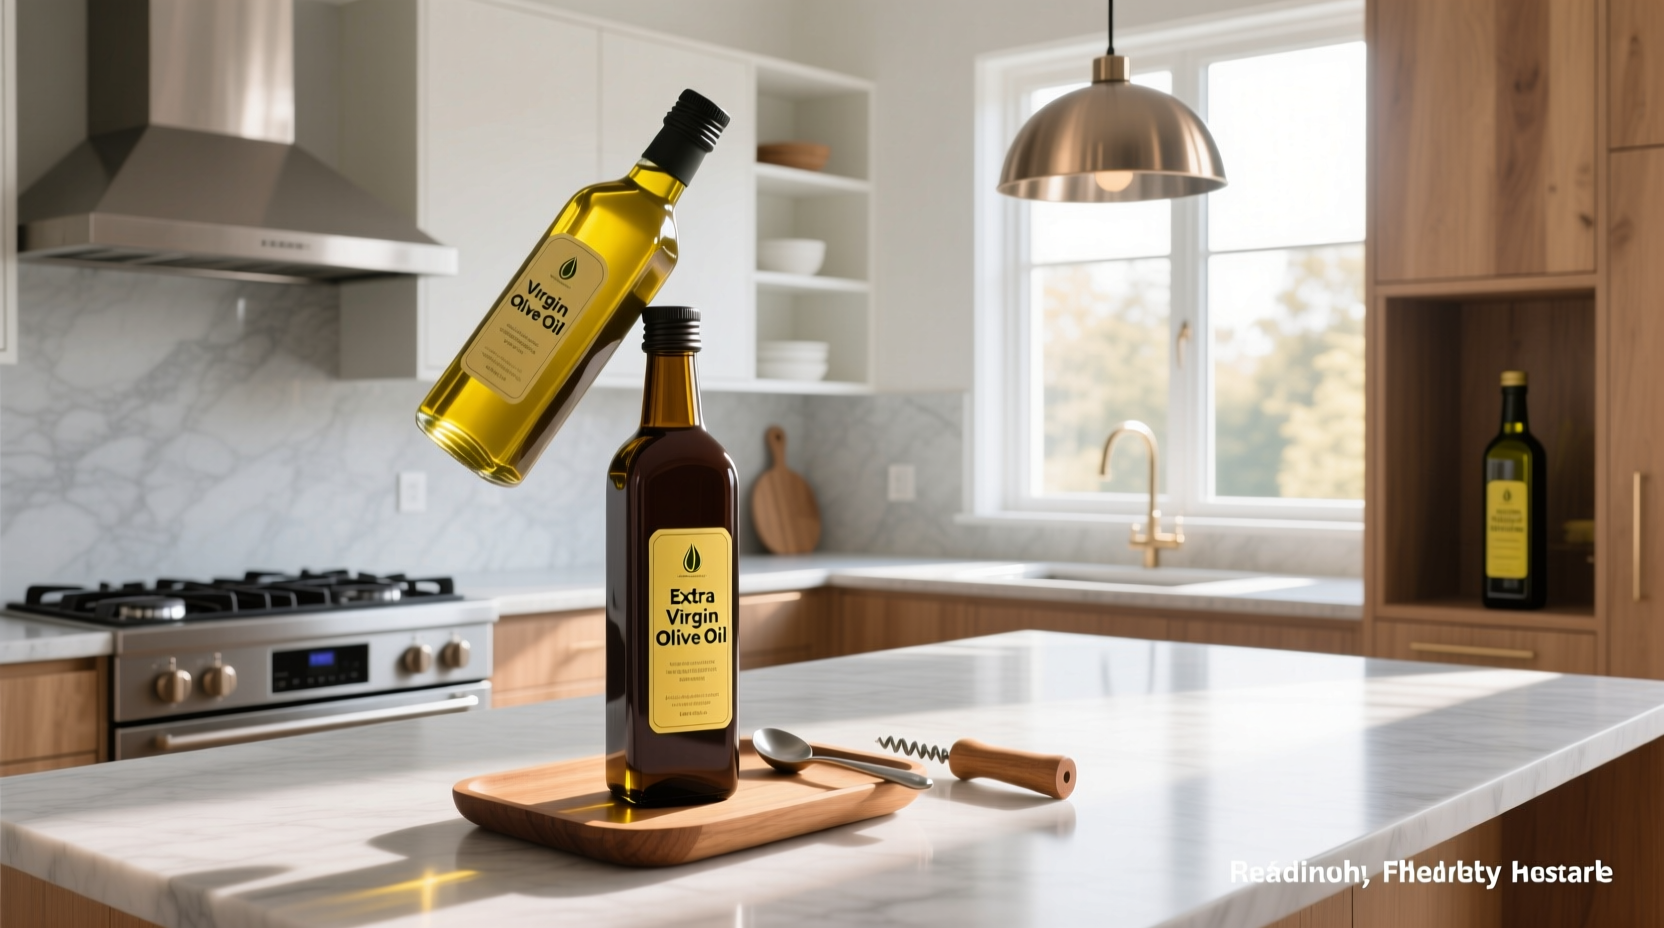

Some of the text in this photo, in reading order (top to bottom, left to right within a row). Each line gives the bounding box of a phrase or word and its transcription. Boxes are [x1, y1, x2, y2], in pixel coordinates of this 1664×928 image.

[527, 279, 569, 318] Virgin
[542, 315, 566, 336] Oil
[670, 588, 715, 605] Extra
[666, 608, 719, 629] Virgin
[656, 626, 727, 646] Olive Oil
